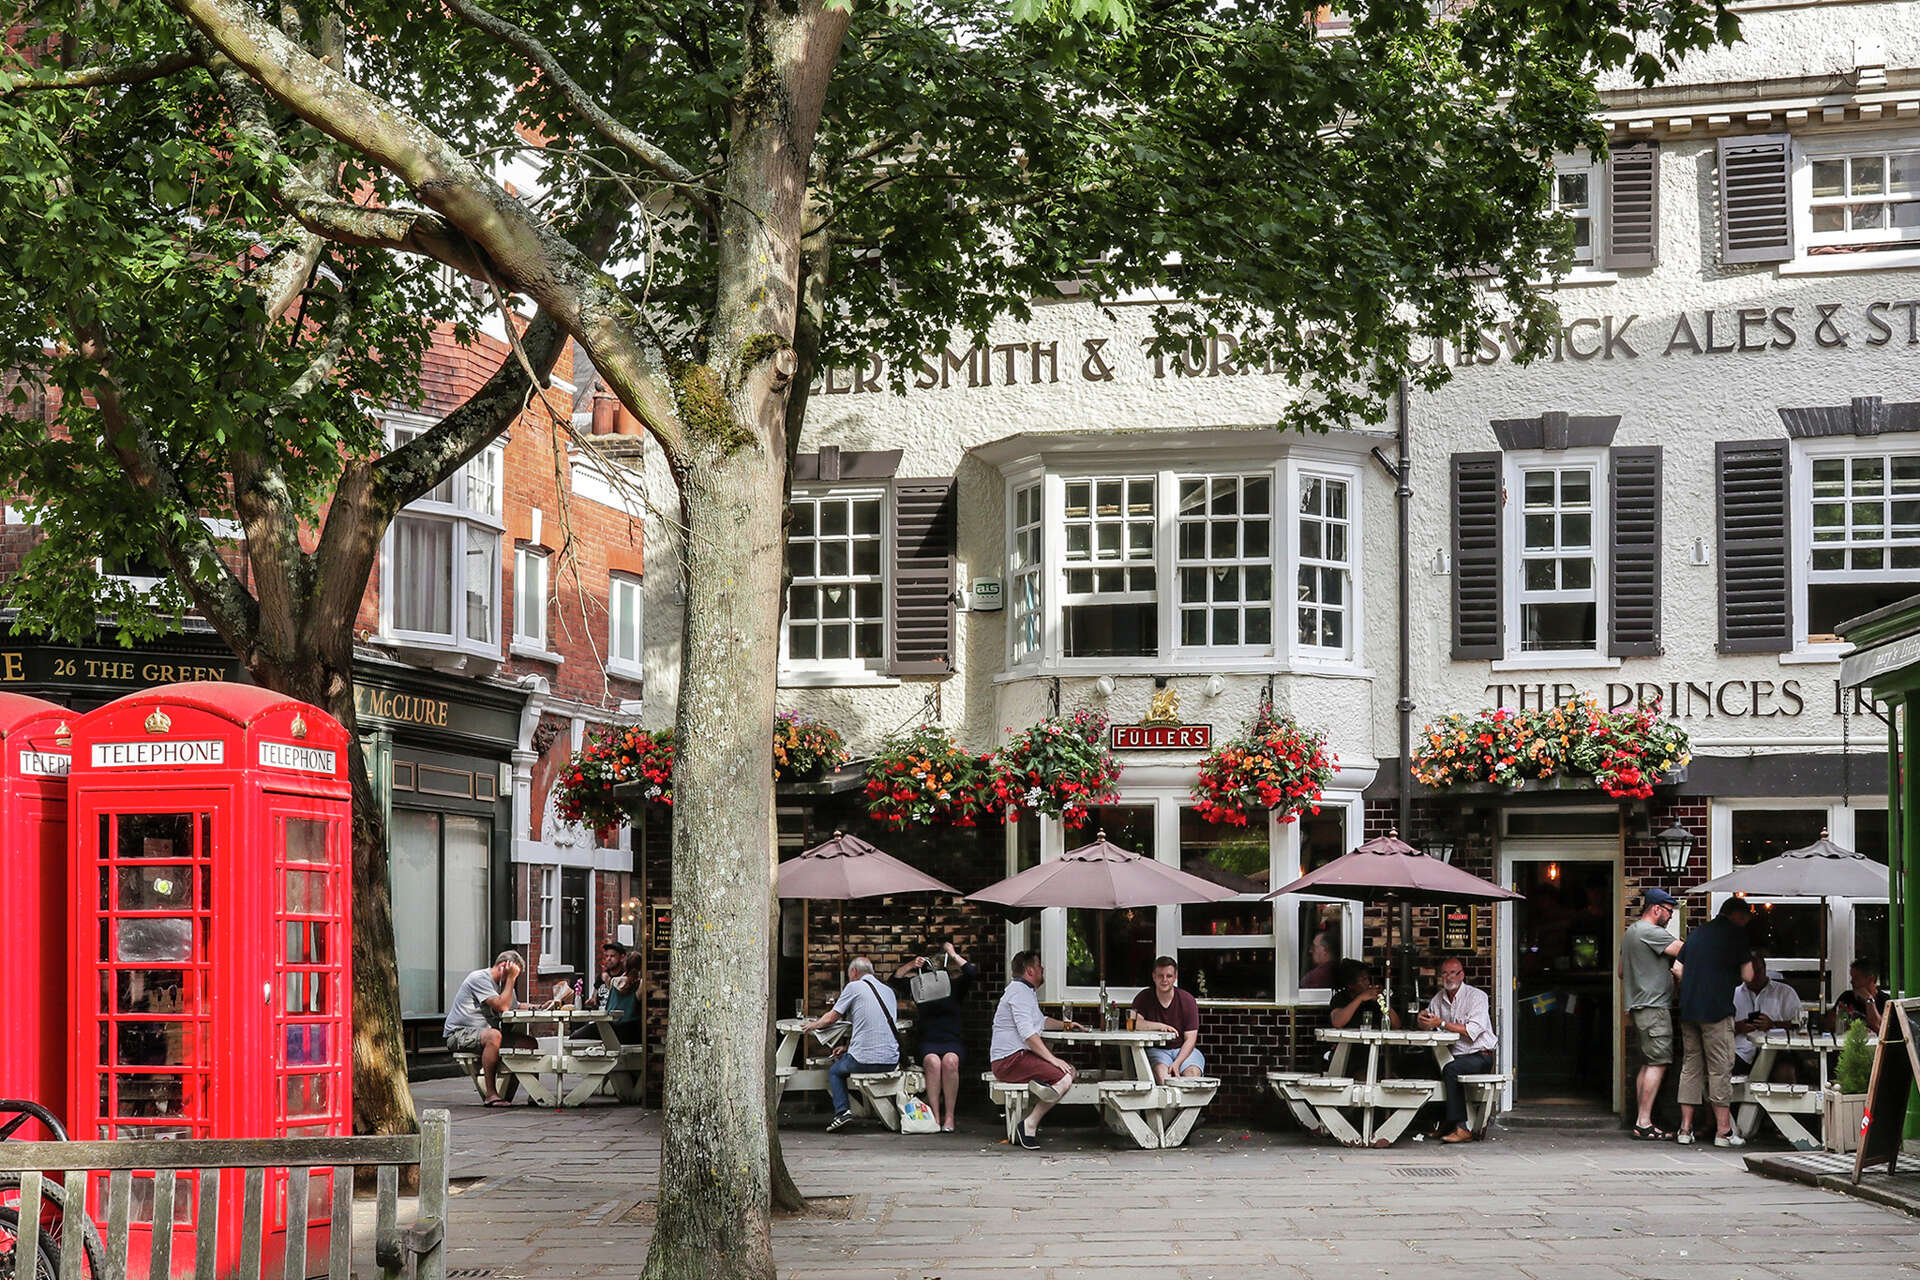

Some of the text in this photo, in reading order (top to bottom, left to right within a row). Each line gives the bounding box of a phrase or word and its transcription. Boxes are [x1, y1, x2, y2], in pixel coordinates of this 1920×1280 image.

[914, 339, 1059, 390] SMITH
[1081, 337, 1116, 383] &
[1662, 307, 1798, 357] ALES
[1814, 303, 1850, 348] &
[0, 652, 226, 683] E 26 THE GREEN
[368, 689, 449, 727] McCLURE
[1485, 683, 1577, 713] THE
[1606, 680, 1804, 719] PRINCES
[98, 741, 221, 765] TELEPHONE
[1117, 728, 1204, 747] FULLER'S
[261, 743, 333, 773] TELEPHONE
